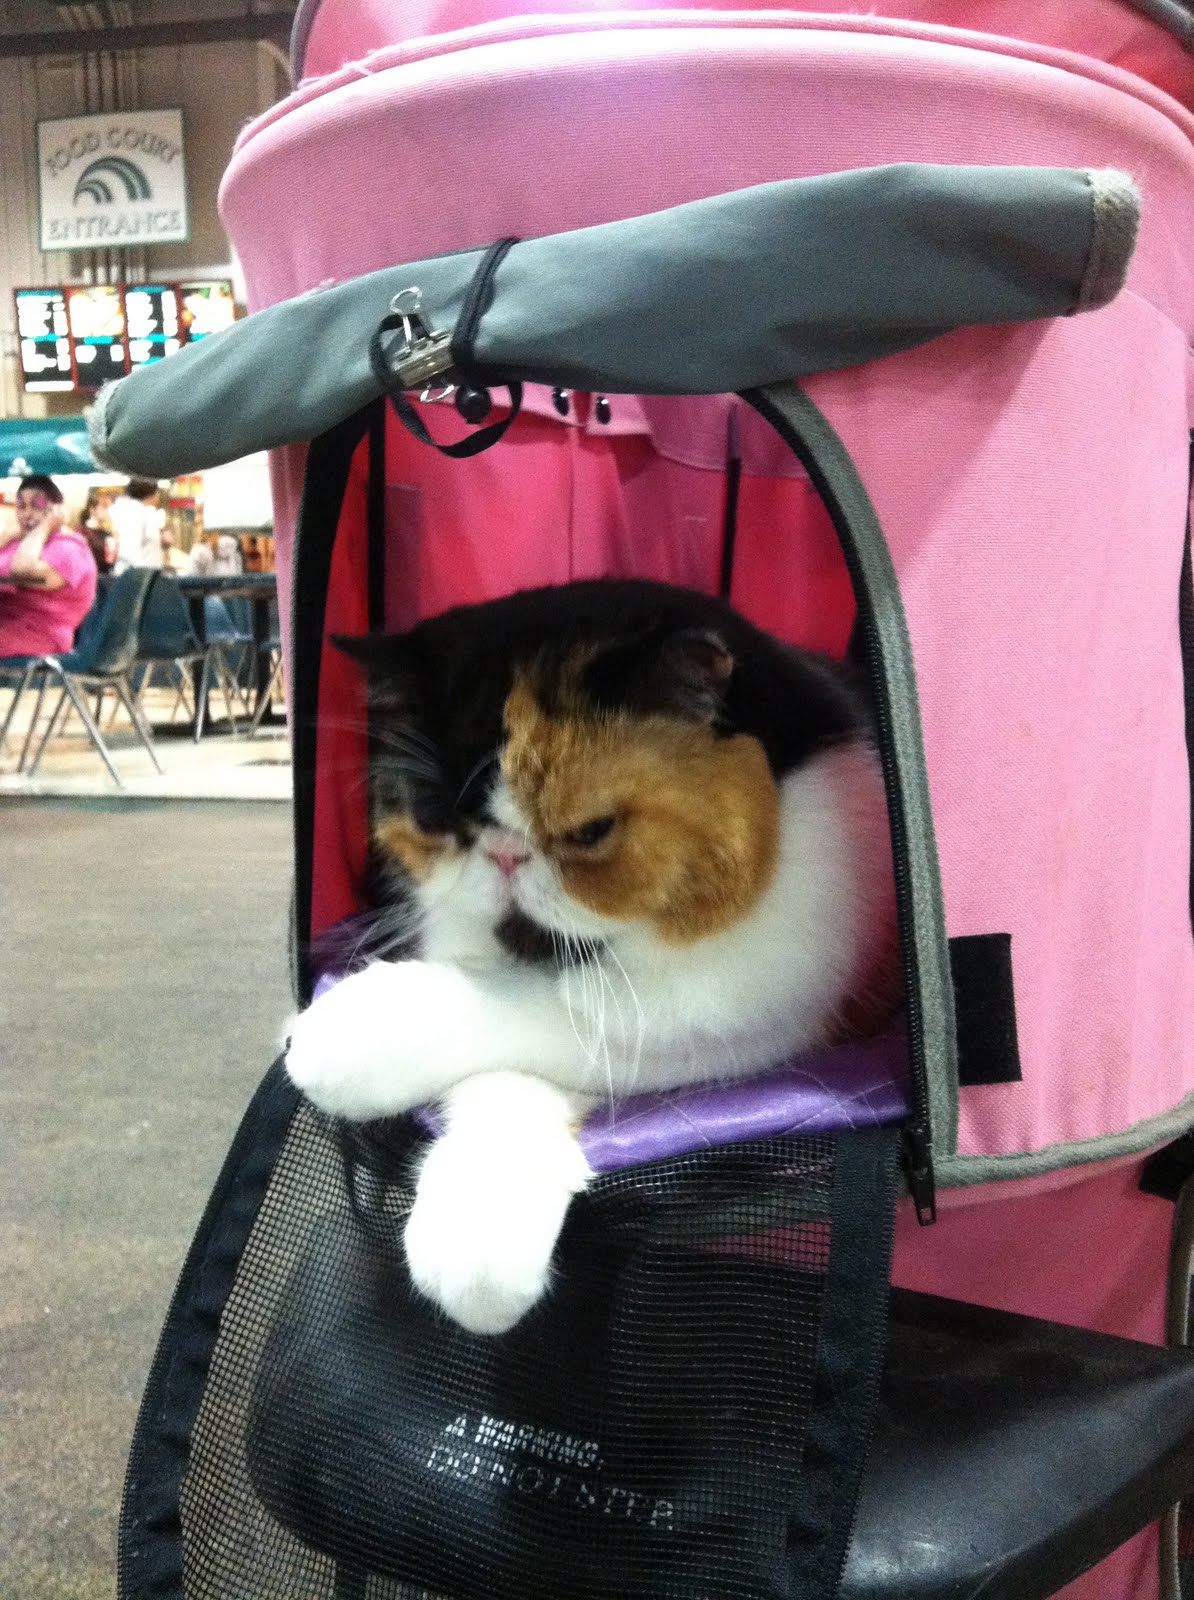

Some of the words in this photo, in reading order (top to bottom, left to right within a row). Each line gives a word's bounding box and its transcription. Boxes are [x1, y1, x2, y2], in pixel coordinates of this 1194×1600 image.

[47, 132, 101, 179] FOOD
[107, 127, 180, 165] COURT
[48, 209, 182, 242] ENTRANCE
